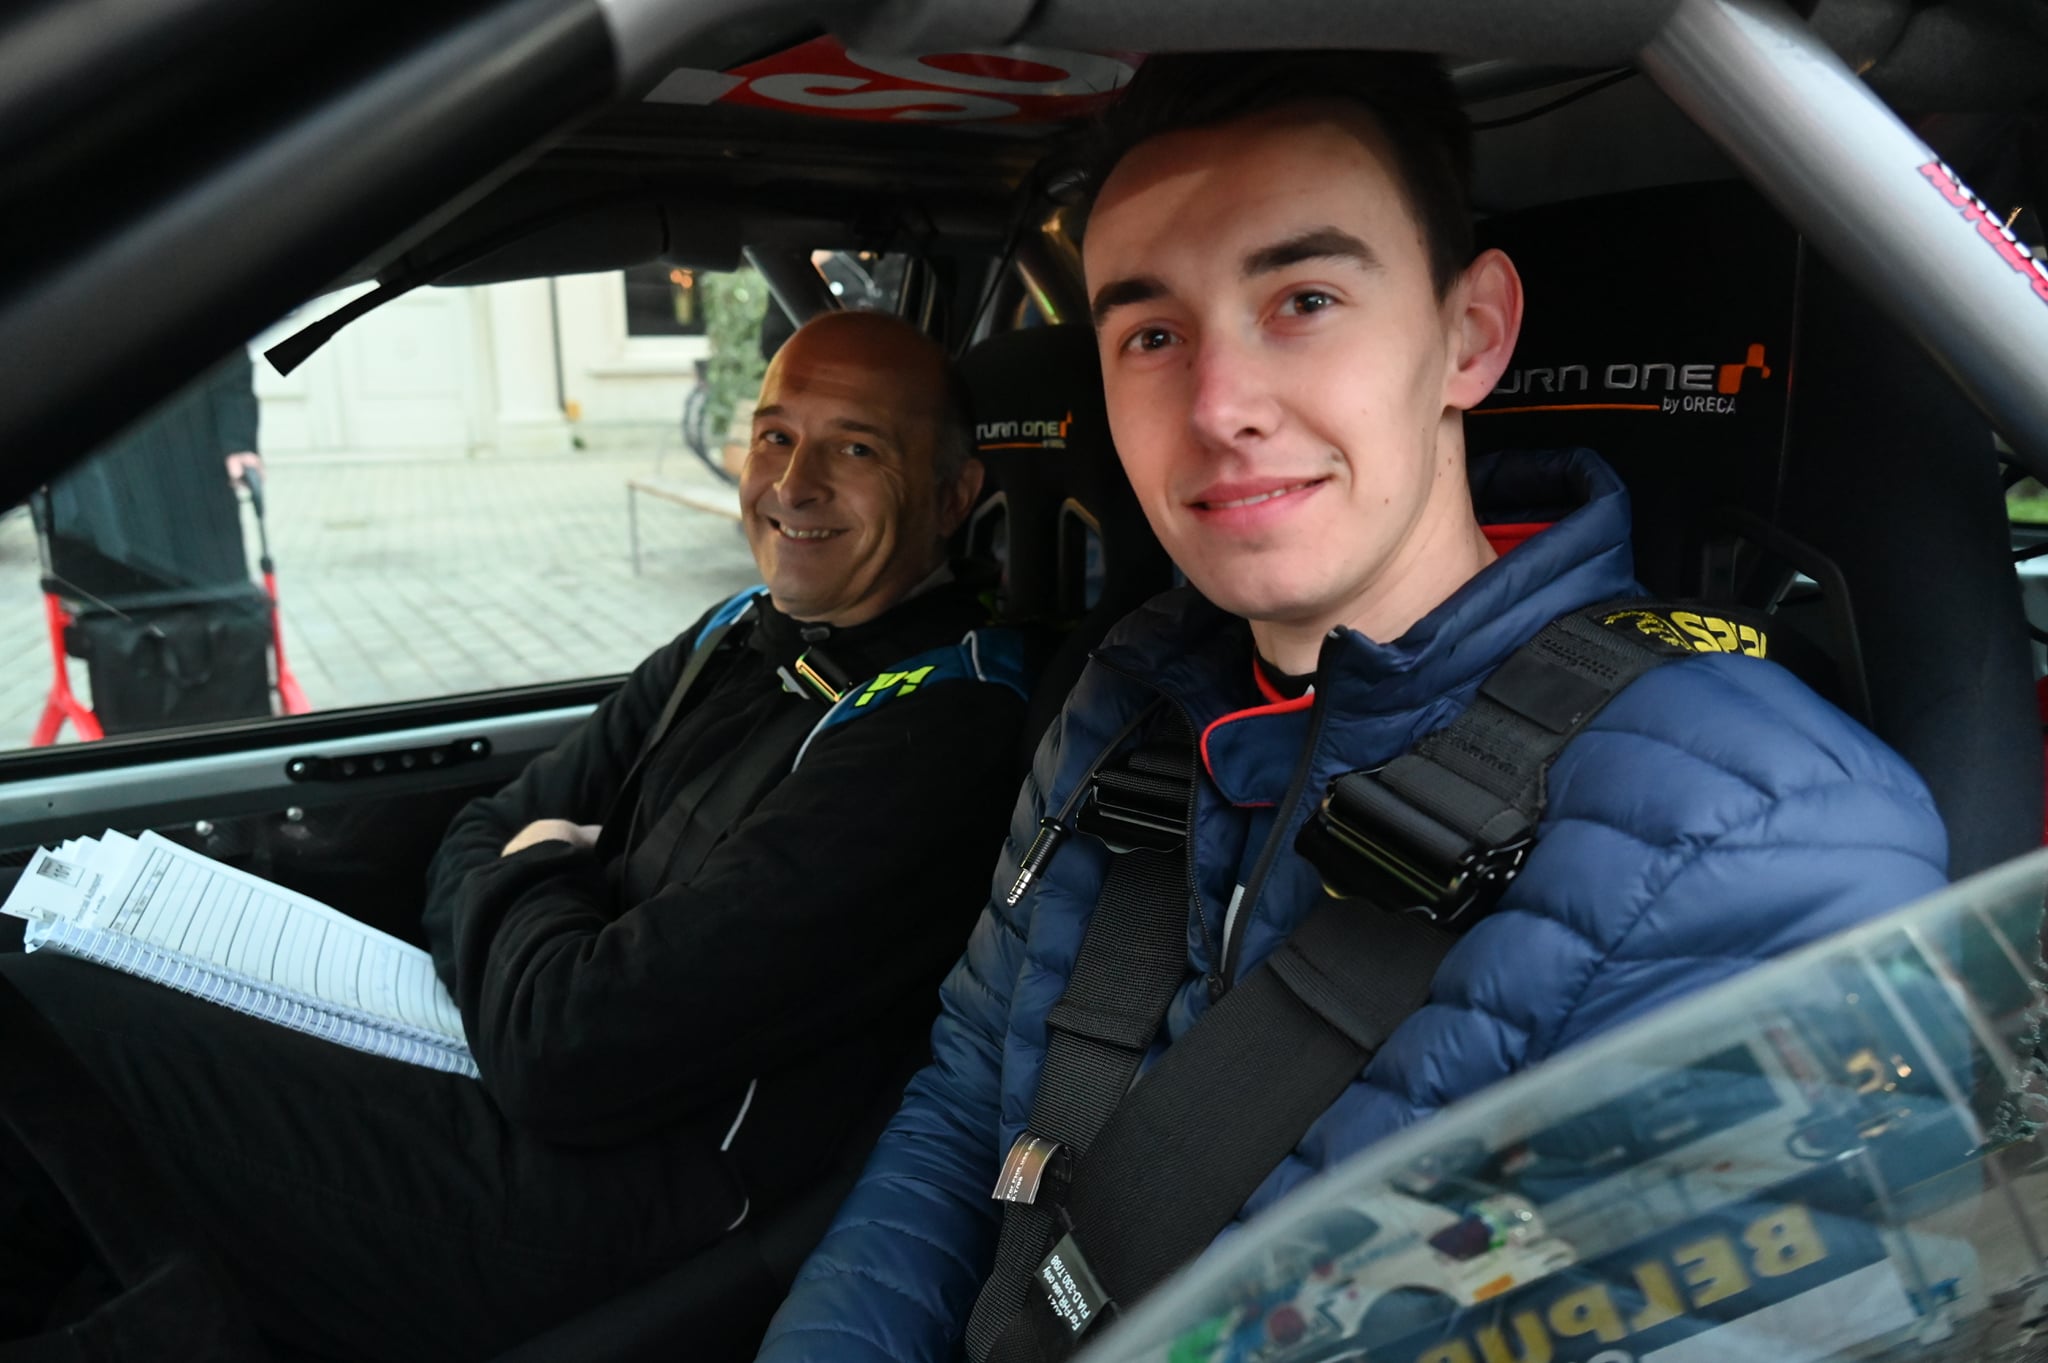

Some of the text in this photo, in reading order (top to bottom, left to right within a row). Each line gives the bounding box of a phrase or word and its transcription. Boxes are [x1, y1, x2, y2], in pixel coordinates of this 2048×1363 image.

[1493, 364, 1715, 394] URN ONE
[1662, 395, 1736, 414] by ORECA
[1022, 421, 1059, 437] ONE
[1042, 1265, 1081, 1331] For FHR use only
[1077, 1298, 1091, 1320] FIA
